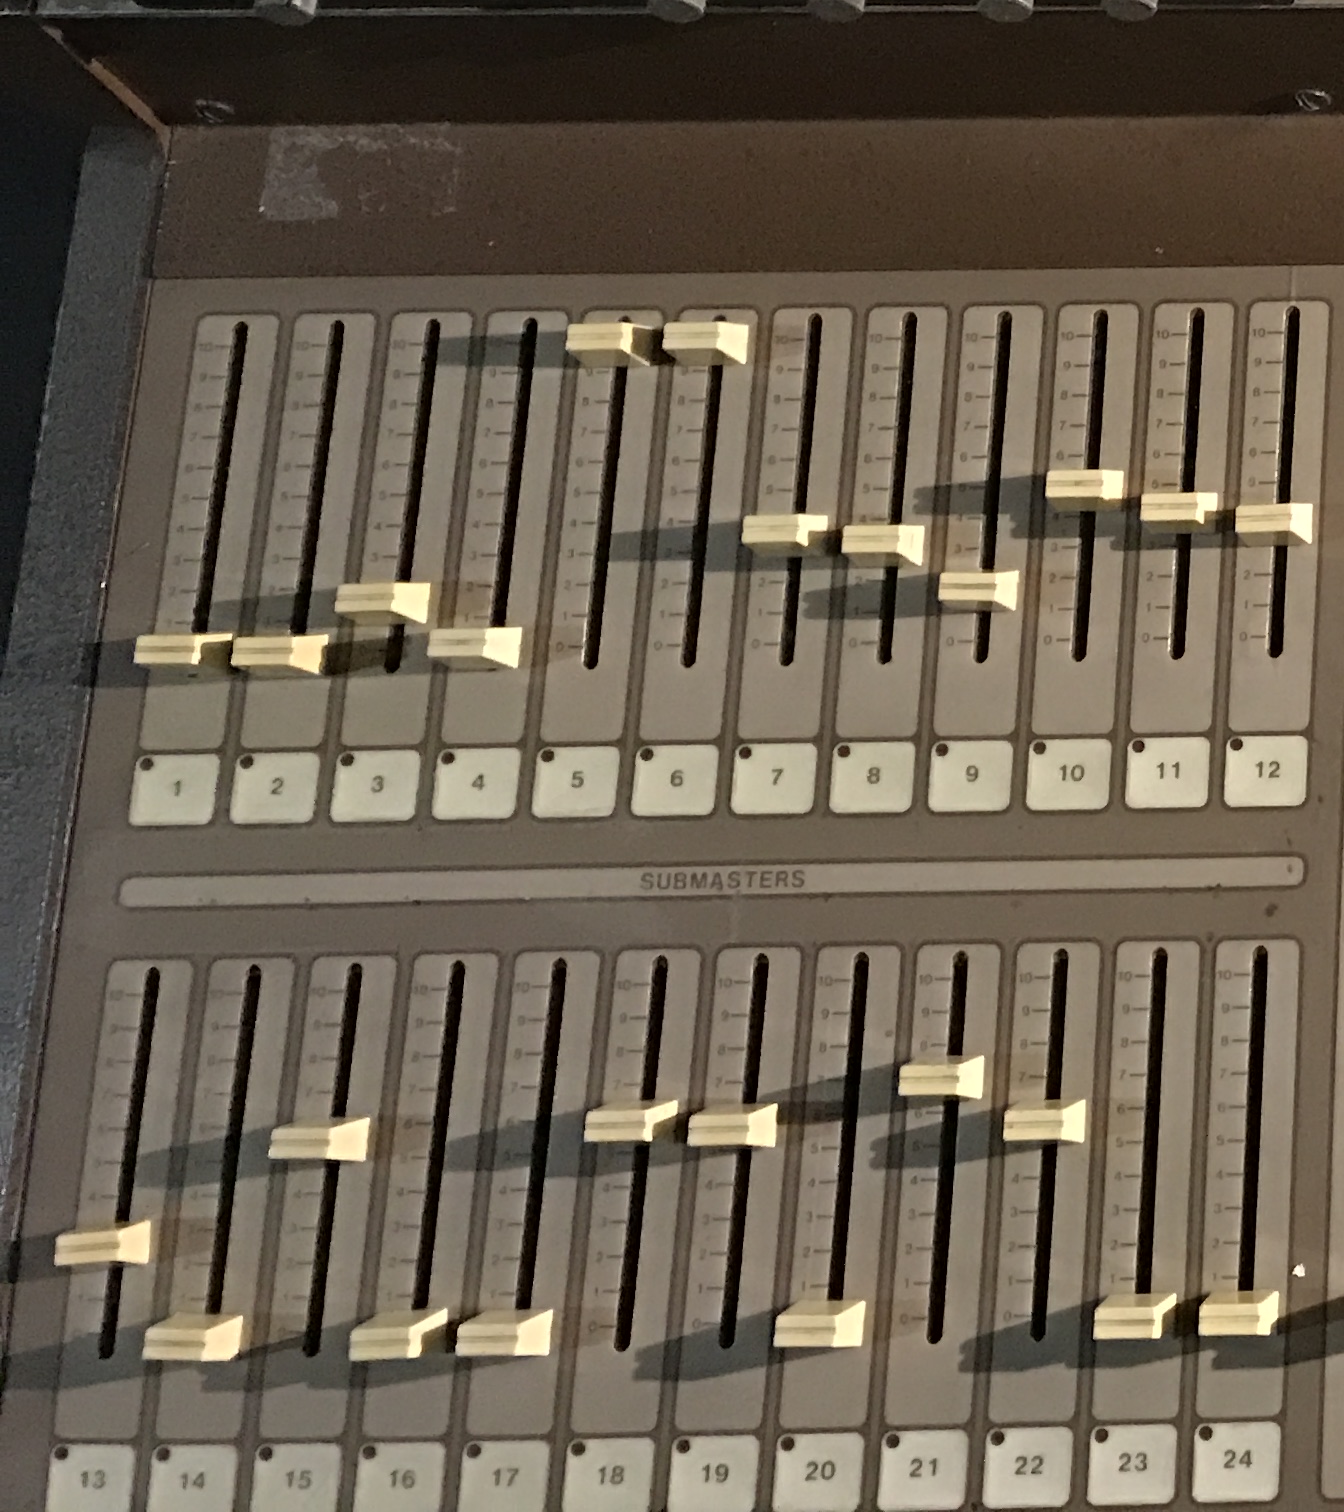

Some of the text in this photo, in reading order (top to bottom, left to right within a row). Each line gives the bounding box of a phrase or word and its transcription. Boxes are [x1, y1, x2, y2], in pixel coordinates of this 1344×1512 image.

[670, 770, 683, 787] 6
[772, 768, 783, 785] 7
[867, 767, 880, 784] 8
[966, 765, 979, 782] 9
[1060, 765, 1085, 781] 10
[1157, 762, 1179, 779] 11
[1256, 761, 1280, 778] 12
[174, 780, 182, 796] 1
[271, 777, 284, 795] 2
[371, 775, 384, 793] 3
[472, 774, 485, 790] 4
[571, 771, 584, 788] 5
[641, 870, 805, 891] SUBMASTERS
[909, 1458, 937, 1478] 21
[1015, 1455, 1044, 1475] 22
[1119, 1452, 1147, 1472] 23
[1224, 1450, 1252, 1469] 24
[81, 1470, 106, 1489] 13
[390, 1470, 415, 1489] 16
[493, 1468, 519, 1487] 17
[599, 1466, 624, 1485] 18
[703, 1464, 729, 1483] 19
[805, 1460, 836, 1481] 20
[181, 1472, 205, 1490] 14
[286, 1470, 312, 1490] 15
